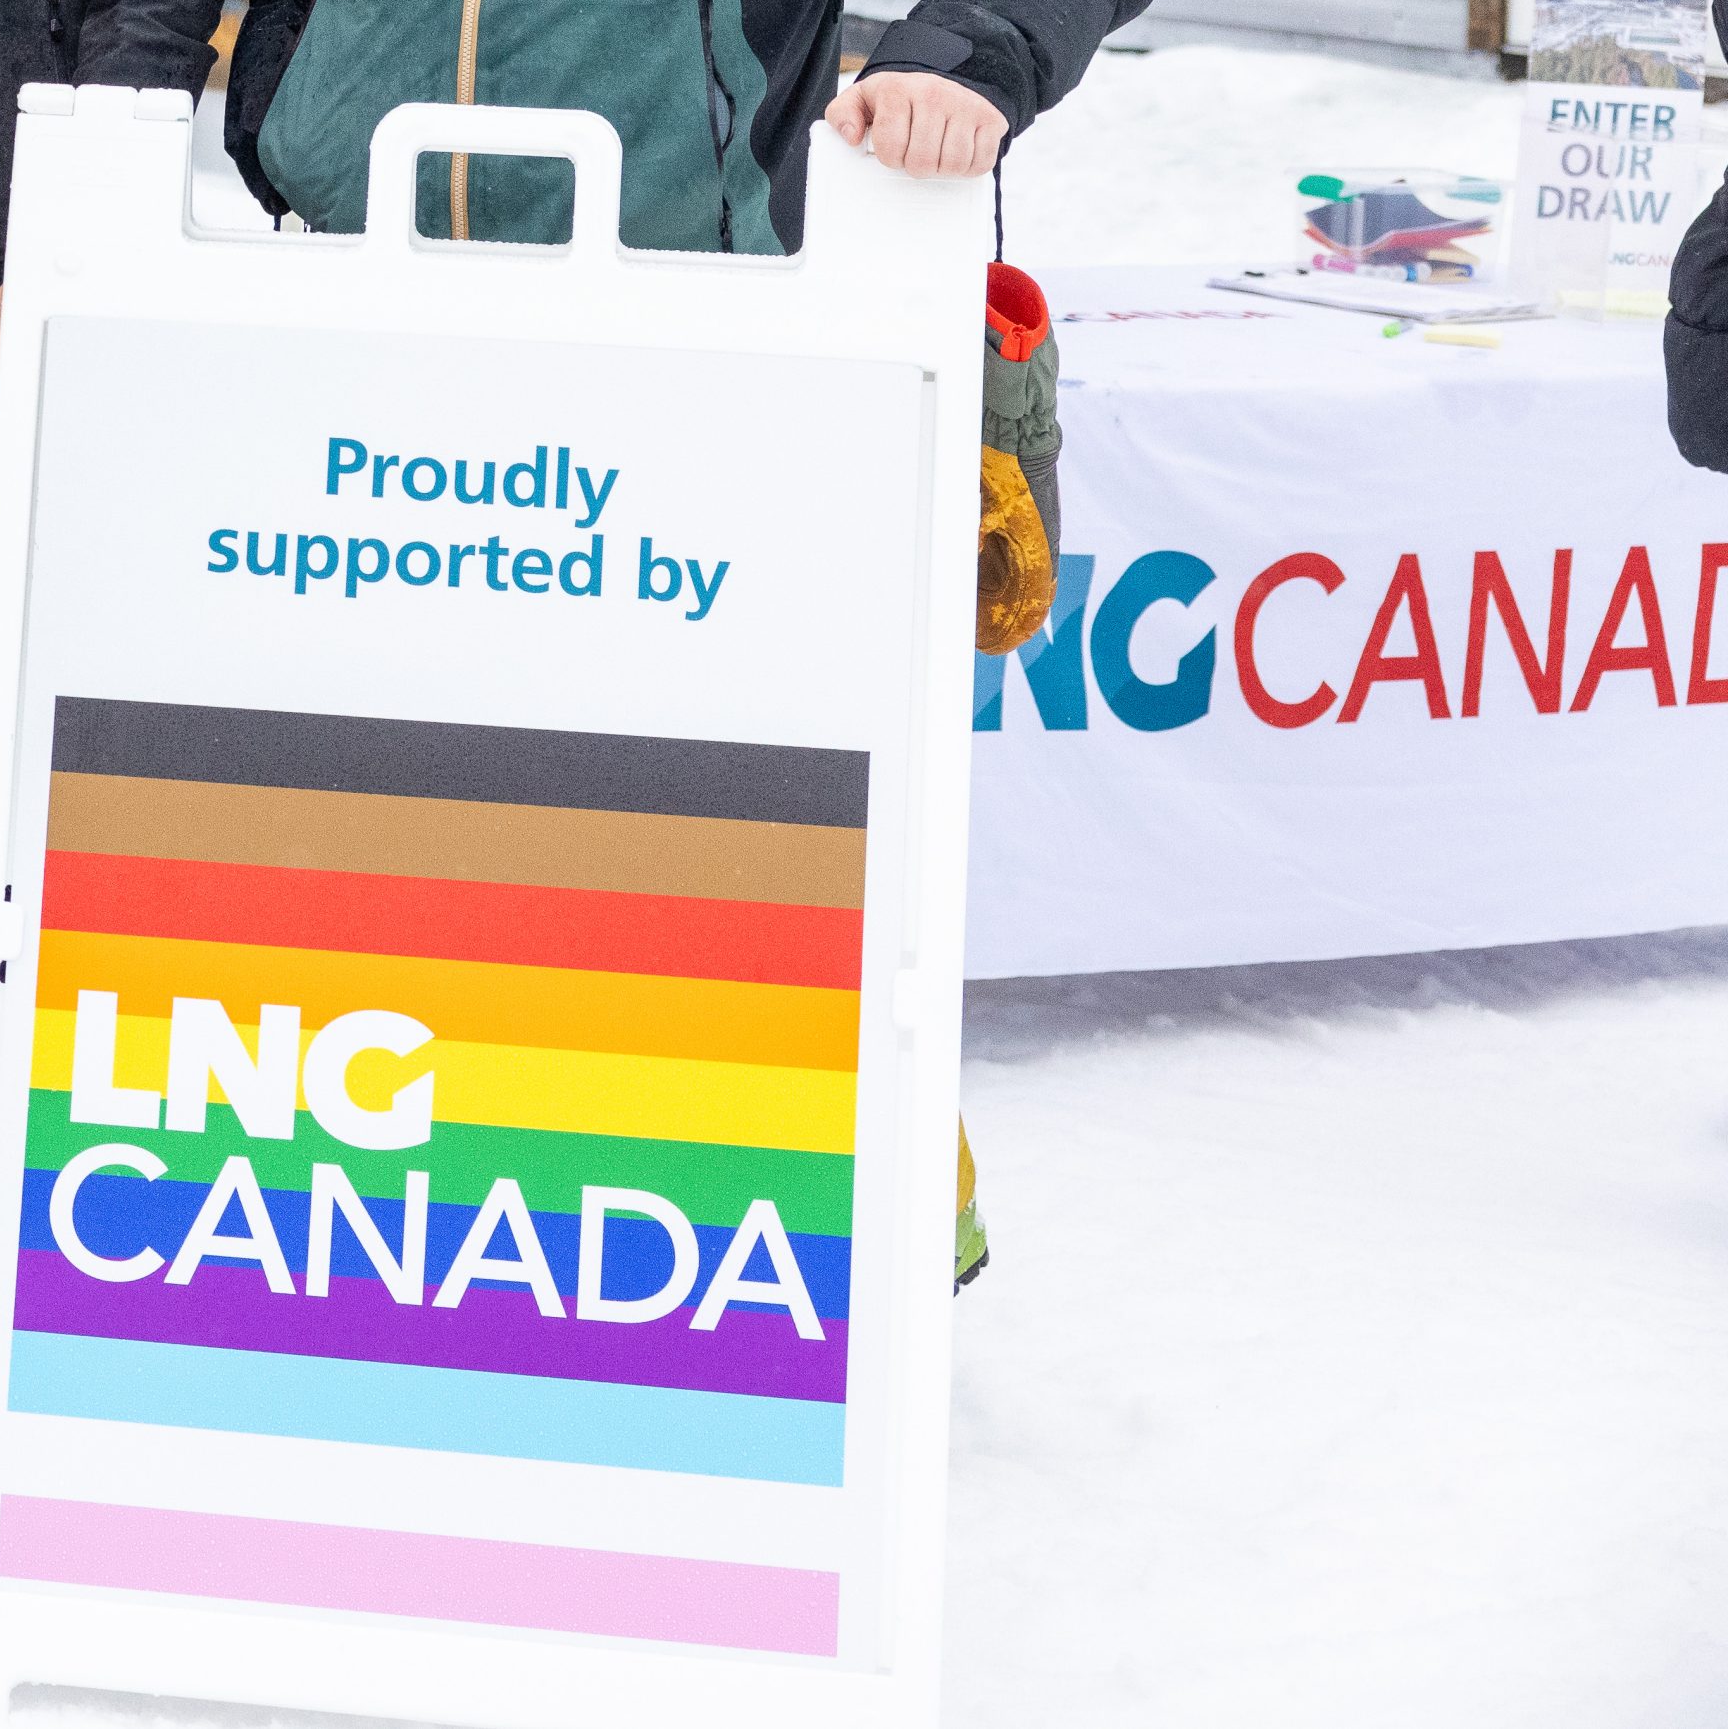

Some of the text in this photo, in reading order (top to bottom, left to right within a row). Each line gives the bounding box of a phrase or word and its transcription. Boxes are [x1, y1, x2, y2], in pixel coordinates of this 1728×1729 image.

[1547, 98, 1678, 142] ENTER
[1561, 142, 1655, 182] OUR
[1536, 185, 1672, 225] DRAW
[324, 436, 620, 529] Proudly
[206, 527, 731, 622] supported by
[69, 990, 434, 1151] LNG
[48, 1142, 826, 1341] CANADA
